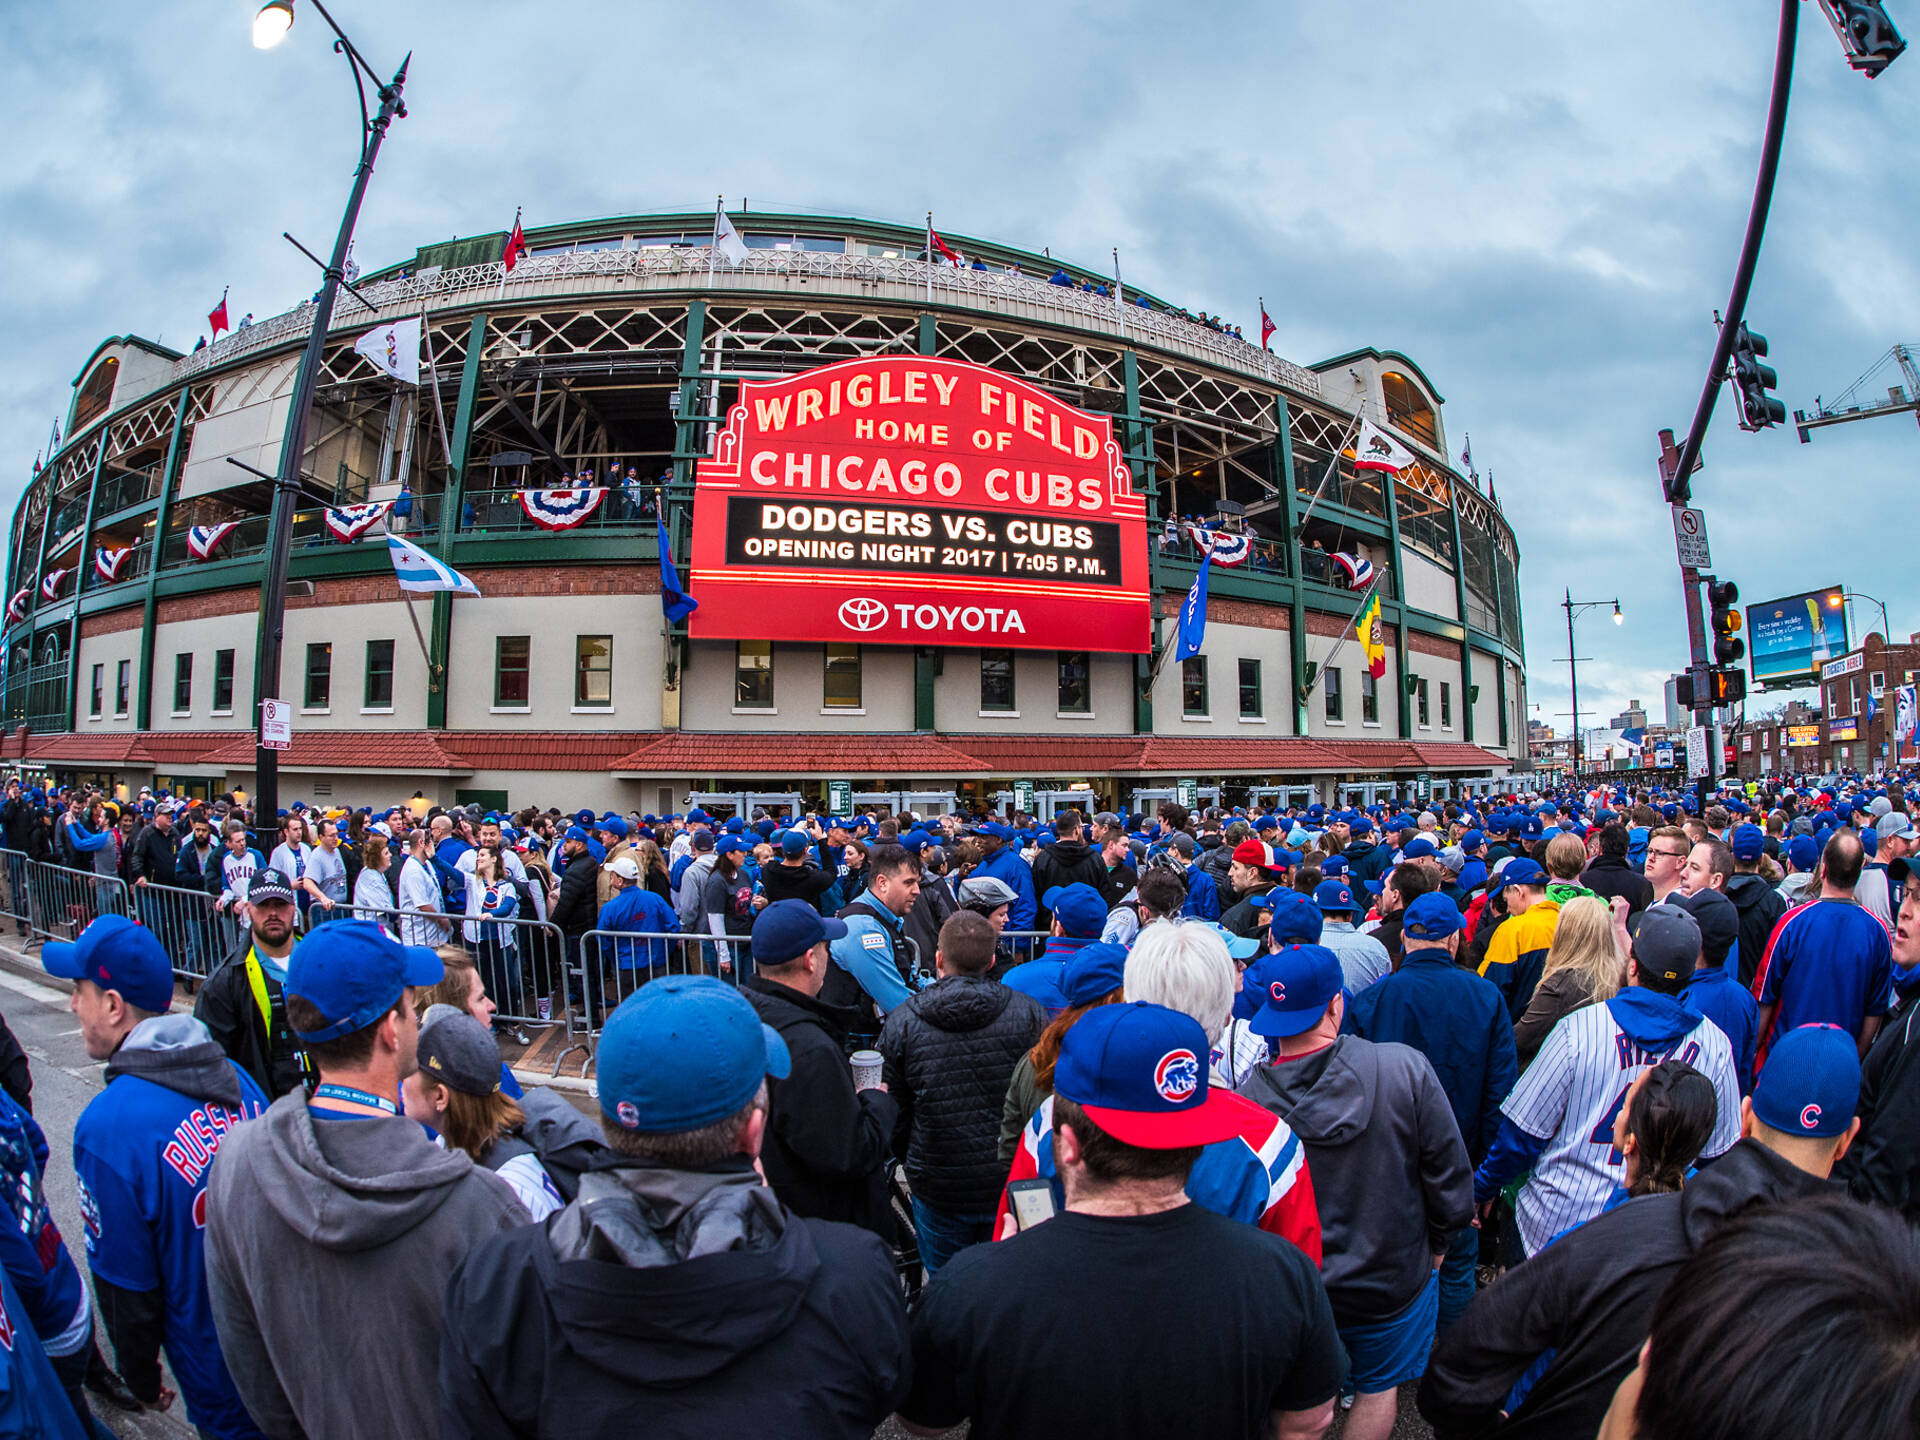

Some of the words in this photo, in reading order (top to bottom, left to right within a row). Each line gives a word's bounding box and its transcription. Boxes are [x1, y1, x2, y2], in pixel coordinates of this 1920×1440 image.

[755, 371, 960, 433] WRIGLEY
[980, 382, 1099, 460] FIELD
[856, 418, 948, 446] HOME
[972, 429, 1014, 452] OF
[750, 450, 962, 497] CHICAGO
[984, 468, 1104, 511] CUBS
[762, 504, 931, 538] DODGERS
[941, 515, 996, 543] VS.
[1006, 521, 1094, 550] CUBS
[744, 537, 855, 560] OPENING
[861, 542, 936, 564] NIGHT
[942, 548, 996, 569] 2017
[1013, 553, 1058, 573] 7:05
[1064, 558, 1107, 576] P.M.
[895, 604, 1026, 634] TOYOTA
[163, 1099, 261, 1188] RUSS
